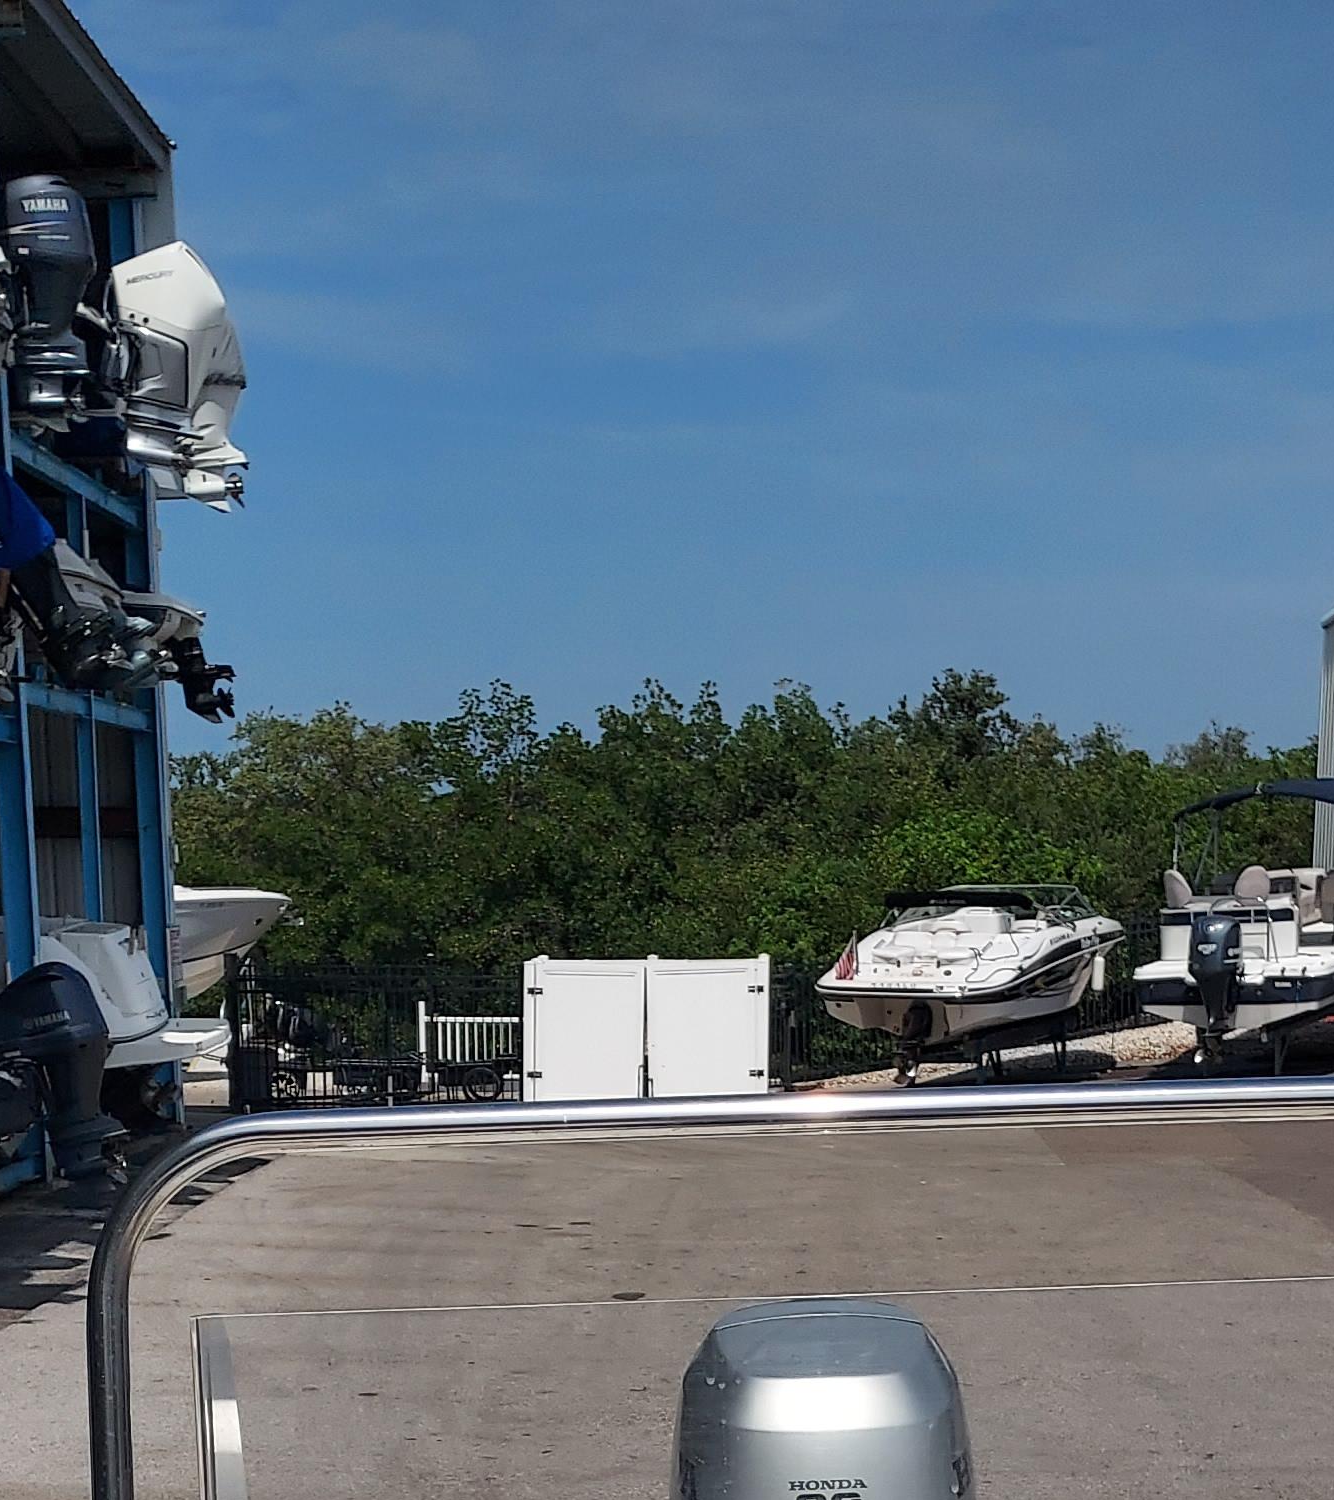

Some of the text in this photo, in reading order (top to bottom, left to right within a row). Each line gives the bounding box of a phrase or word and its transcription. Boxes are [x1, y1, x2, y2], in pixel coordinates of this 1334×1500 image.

[21, 198, 69, 212] YAMAHA
[33, 1010, 71, 1028] YAMAHA
[788, 1479, 868, 1491] HONDA
